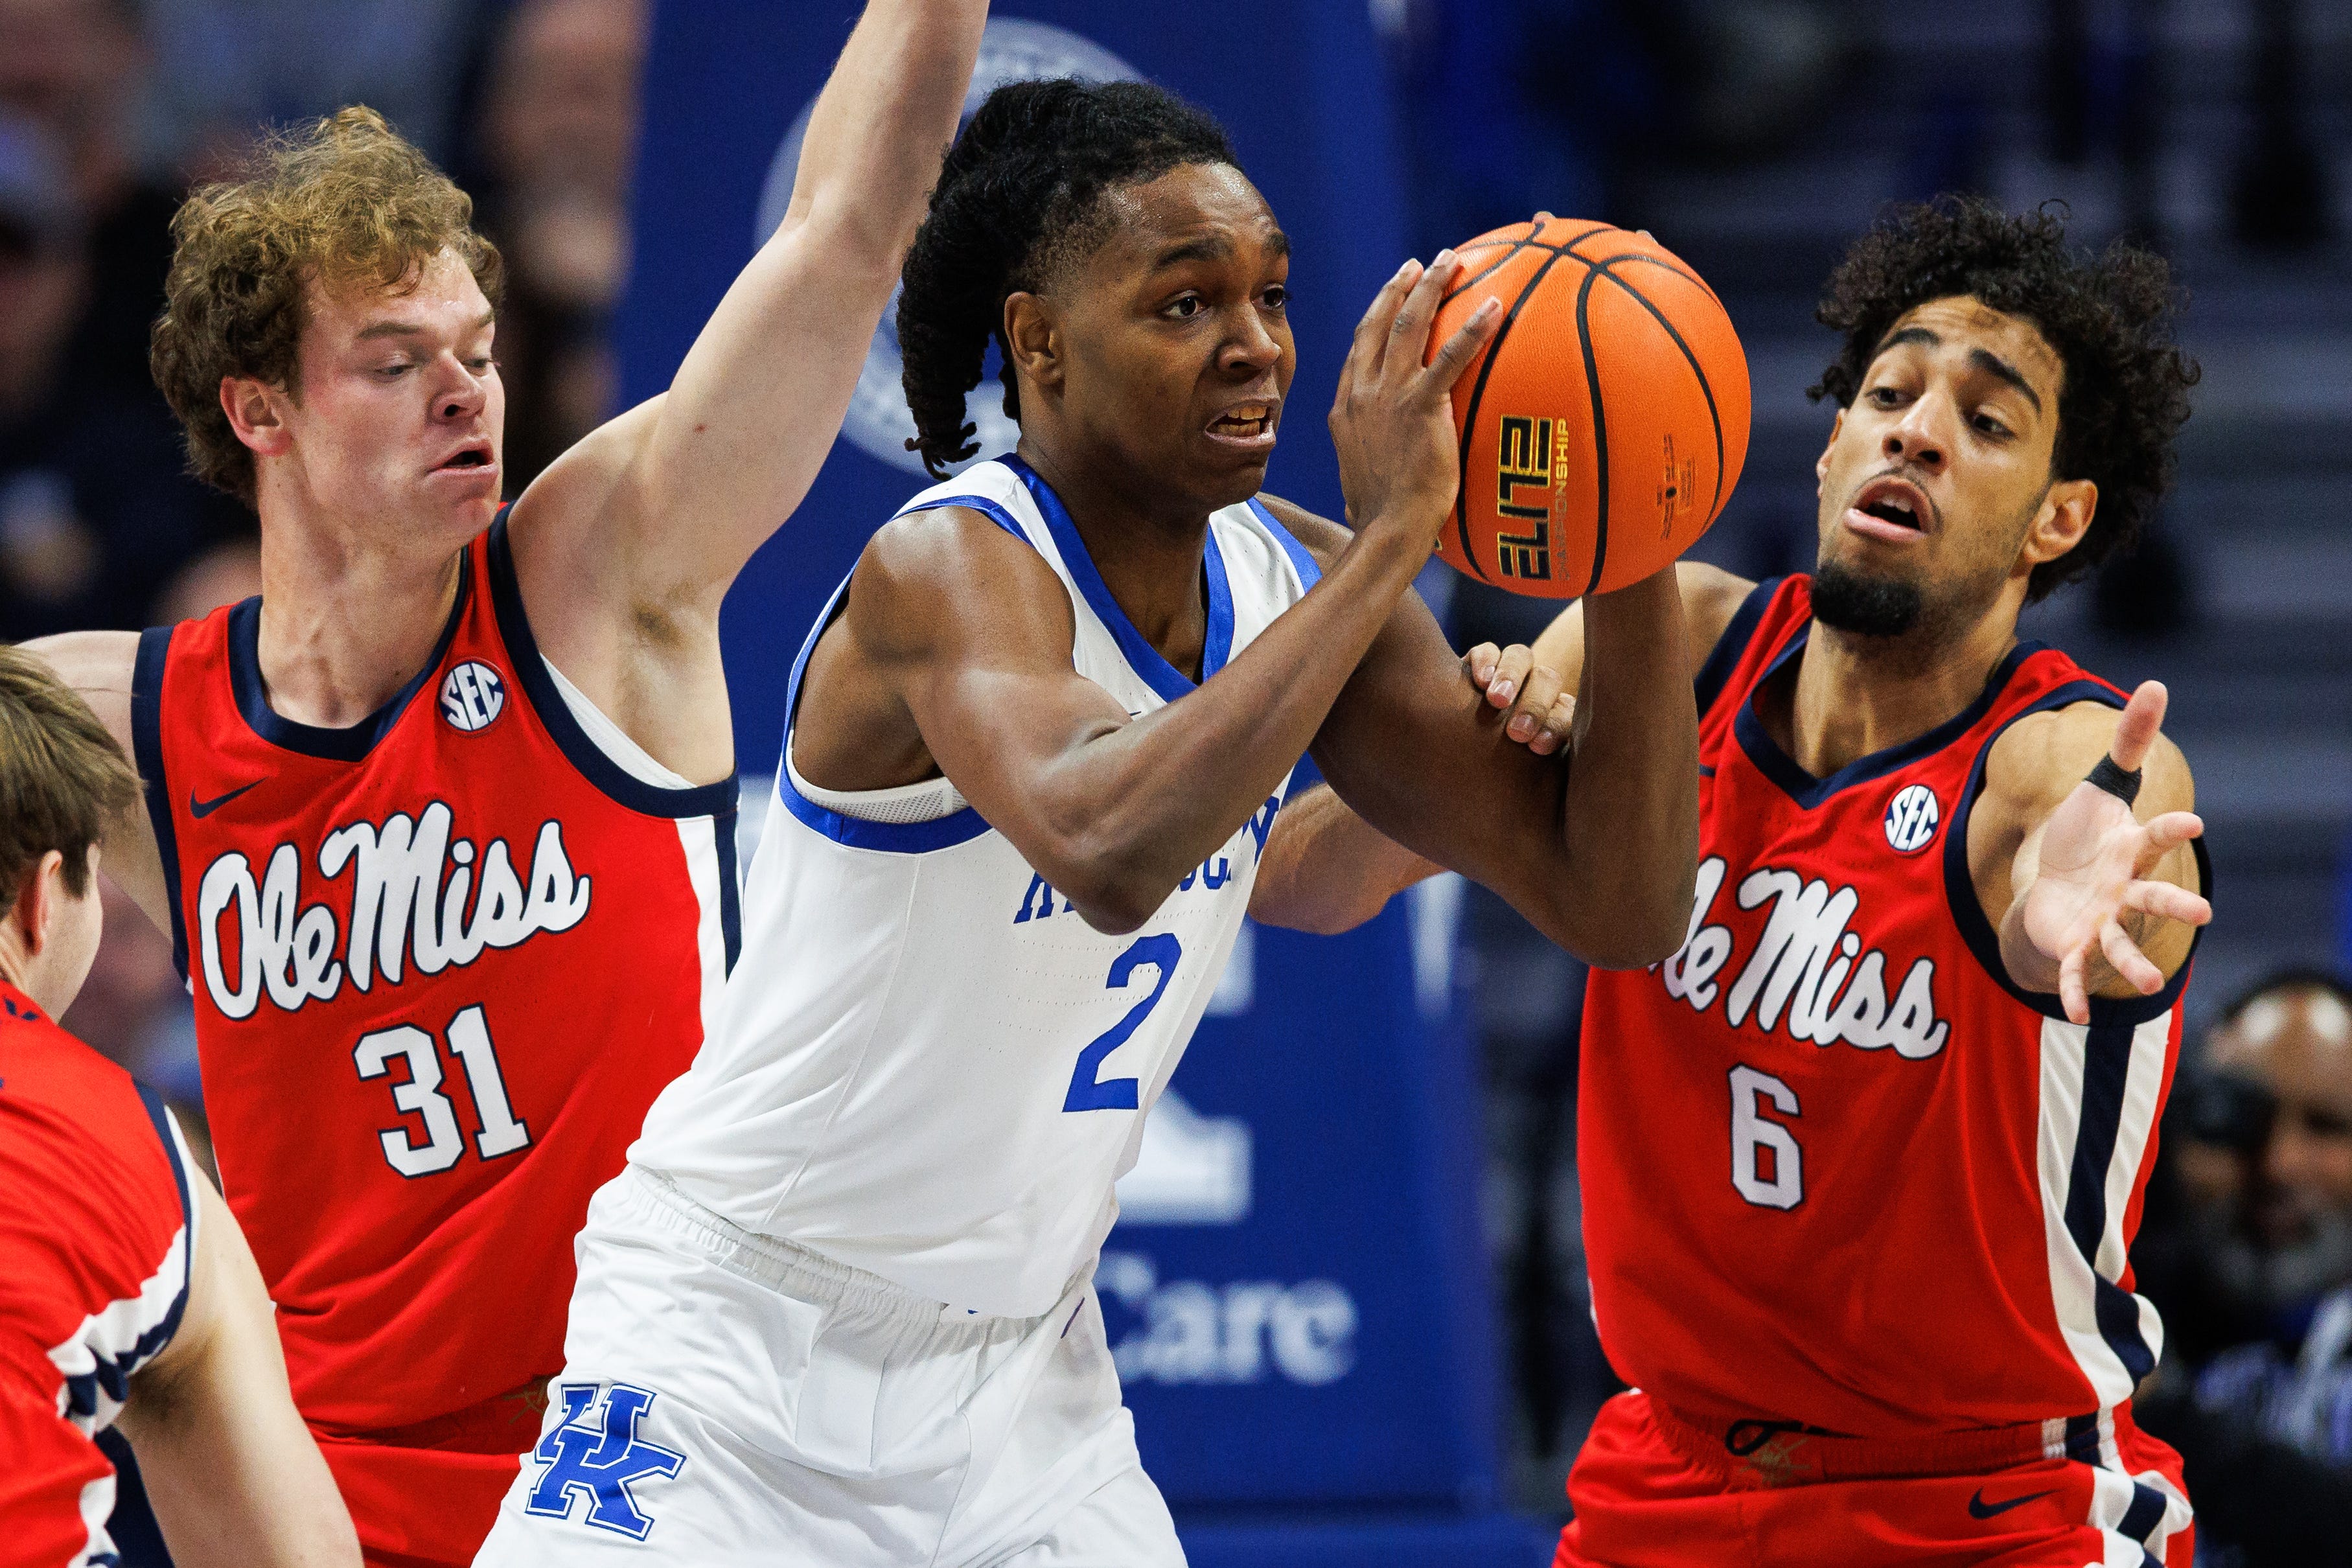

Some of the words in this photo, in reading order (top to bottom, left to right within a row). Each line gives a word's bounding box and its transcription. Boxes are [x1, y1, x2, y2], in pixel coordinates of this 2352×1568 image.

[1497, 414, 1553, 581] ELITE
[441, 662, 503, 731] SEC
[1885, 785, 1939, 850] SEC
[197, 842, 345, 1021] Ole
[317, 799, 592, 994] Miss
[1648, 854, 1735, 1012] le
[1726, 866, 1951, 1060] Miss
[351, 1001, 533, 1180] 31
[1062, 932, 1182, 1113] 2
[1727, 1063, 1804, 1210] 6
[525, 1382, 687, 1541] UK
